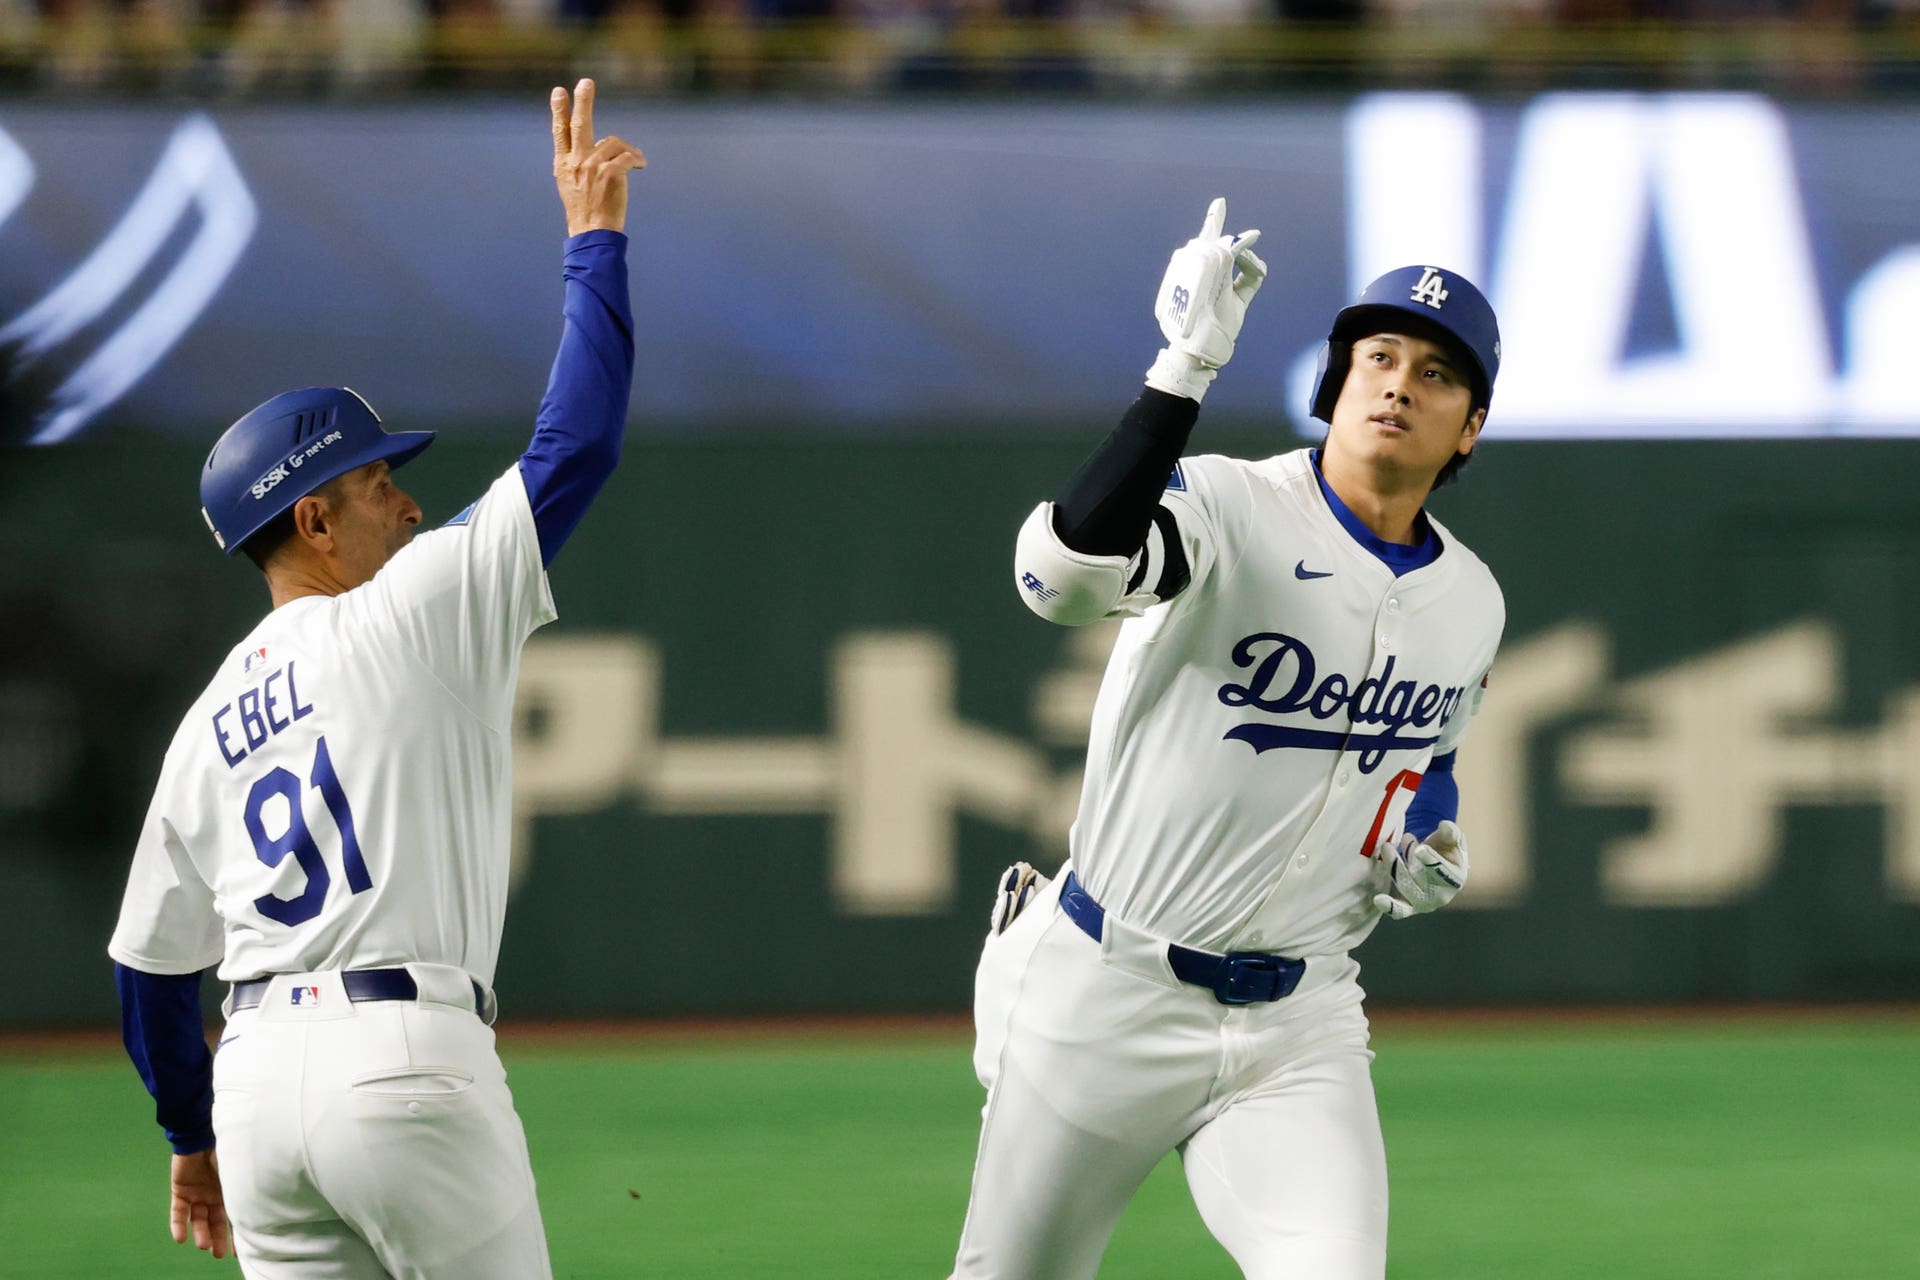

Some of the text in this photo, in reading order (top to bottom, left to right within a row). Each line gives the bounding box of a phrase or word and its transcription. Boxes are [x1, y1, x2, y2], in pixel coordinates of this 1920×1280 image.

[1410, 266, 1448, 309] LA
[251, 462, 291, 500] SCSK
[212, 660, 314, 769] EBEL
[243, 735, 374, 928] 91
